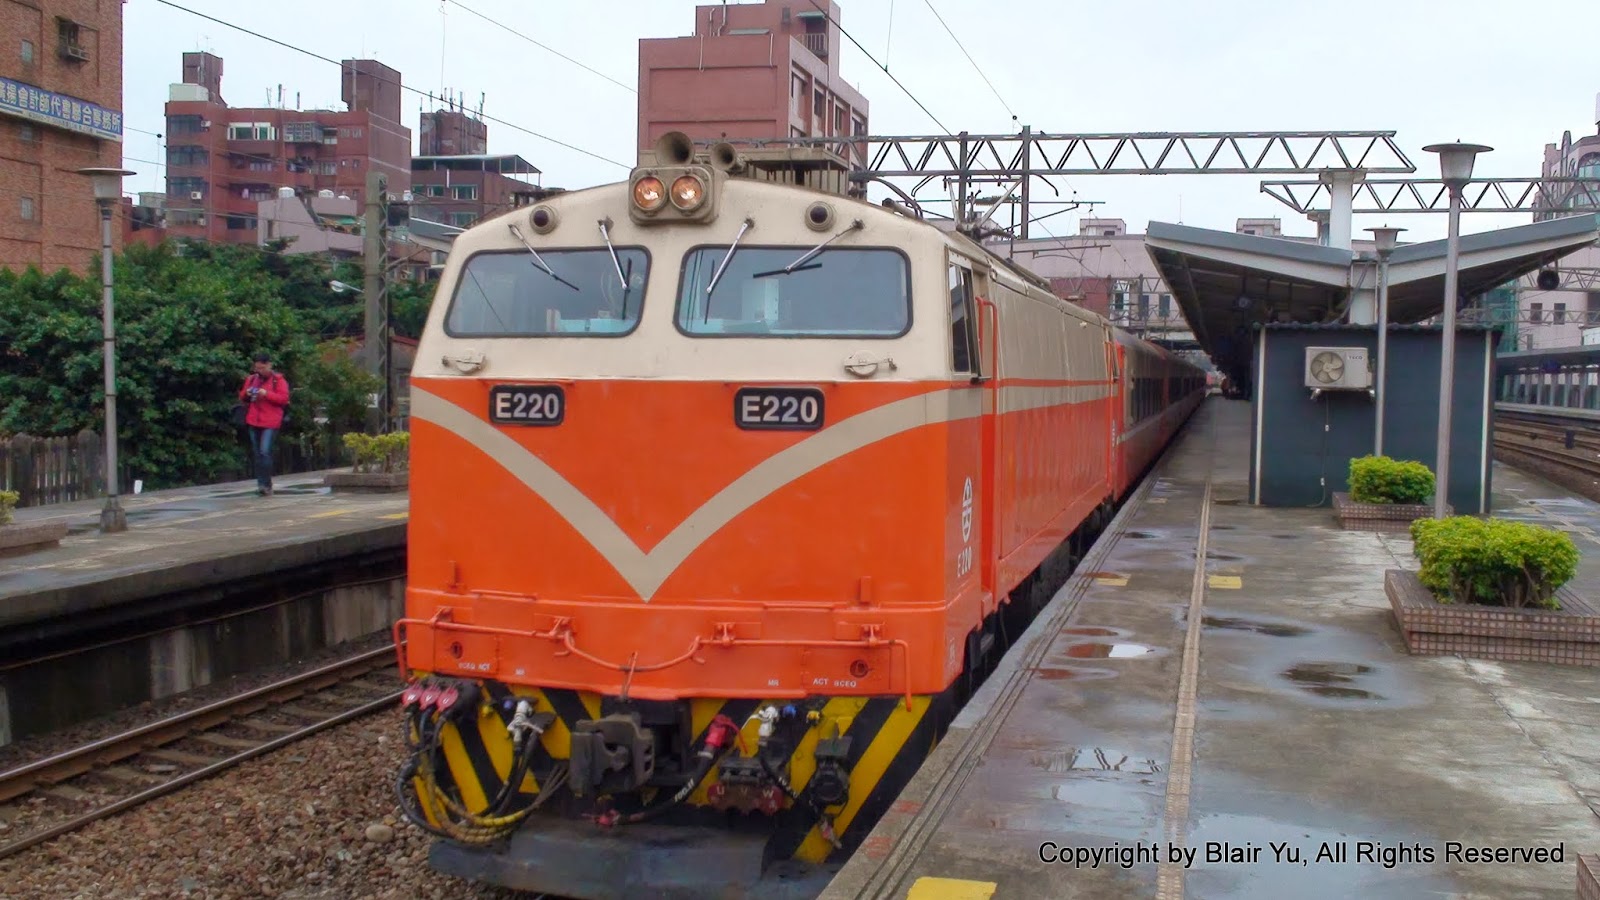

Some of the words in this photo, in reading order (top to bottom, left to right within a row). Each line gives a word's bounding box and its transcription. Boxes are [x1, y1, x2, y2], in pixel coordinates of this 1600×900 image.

[495, 392, 560, 419] E220
[742, 395, 818, 423] E220
[957, 546, 972, 577] E220
[767, 679, 780, 687] MR
[812, 678, 829, 687] ACT
